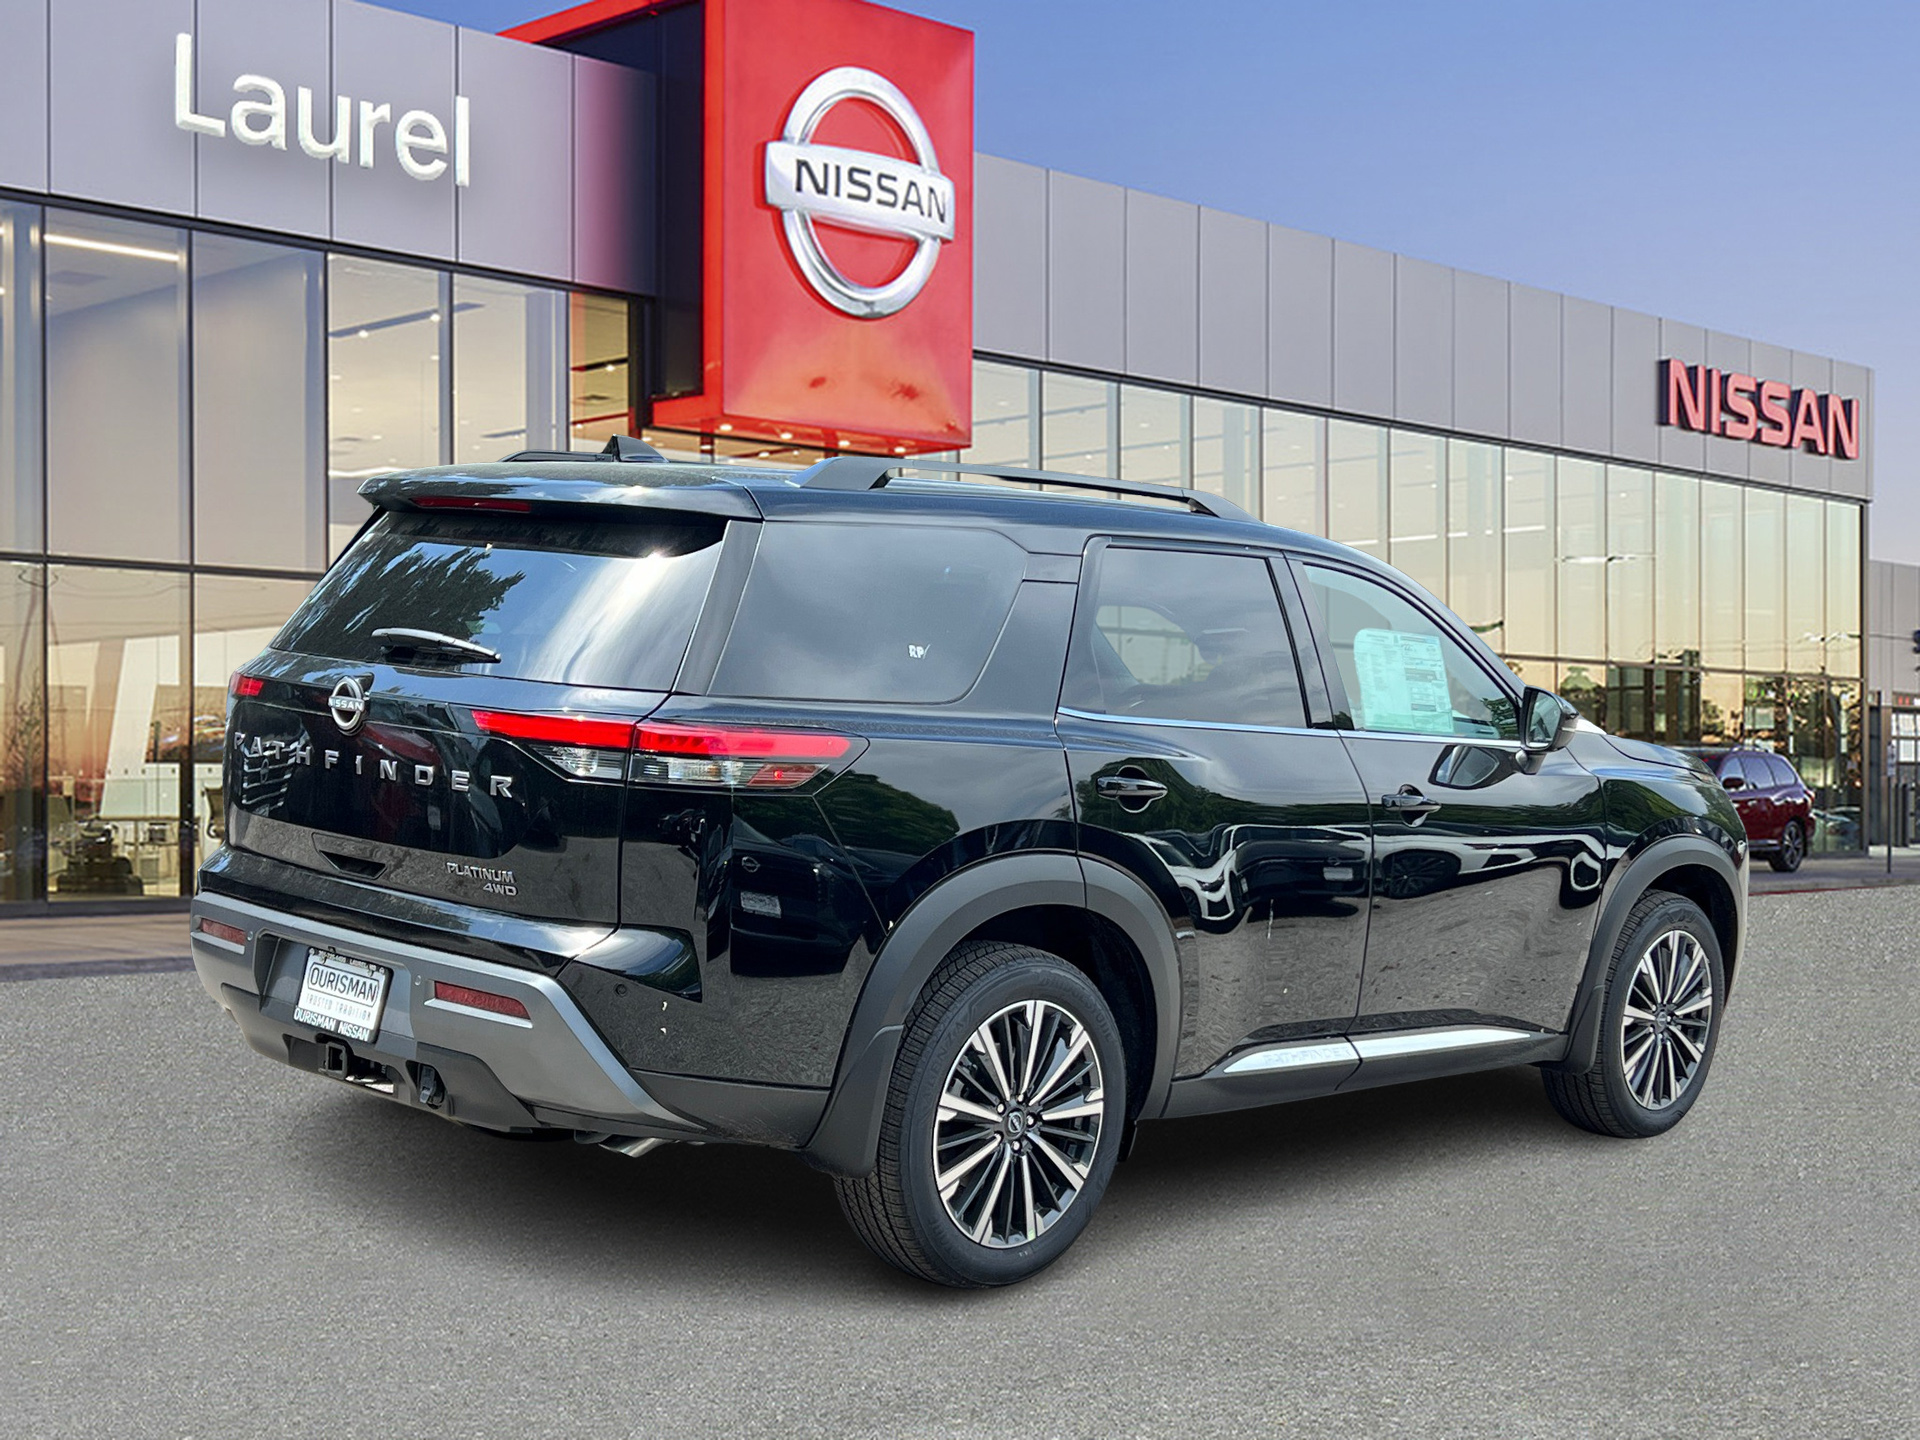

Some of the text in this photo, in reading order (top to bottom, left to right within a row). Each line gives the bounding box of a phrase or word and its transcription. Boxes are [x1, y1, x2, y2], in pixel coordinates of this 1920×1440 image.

[174, 32, 470, 188] Laurel
[794, 158, 947, 224] NISSAN
[1657, 357, 1860, 460] NISSAN
[232, 731, 513, 799] PATHFINDER
[446, 862, 515, 884] PLATINUM
[482, 882, 518, 896] 4WD
[310, 966, 379, 1003] OURISMAN
[293, 1007, 371, 1042] OURISMAN NISSAN
